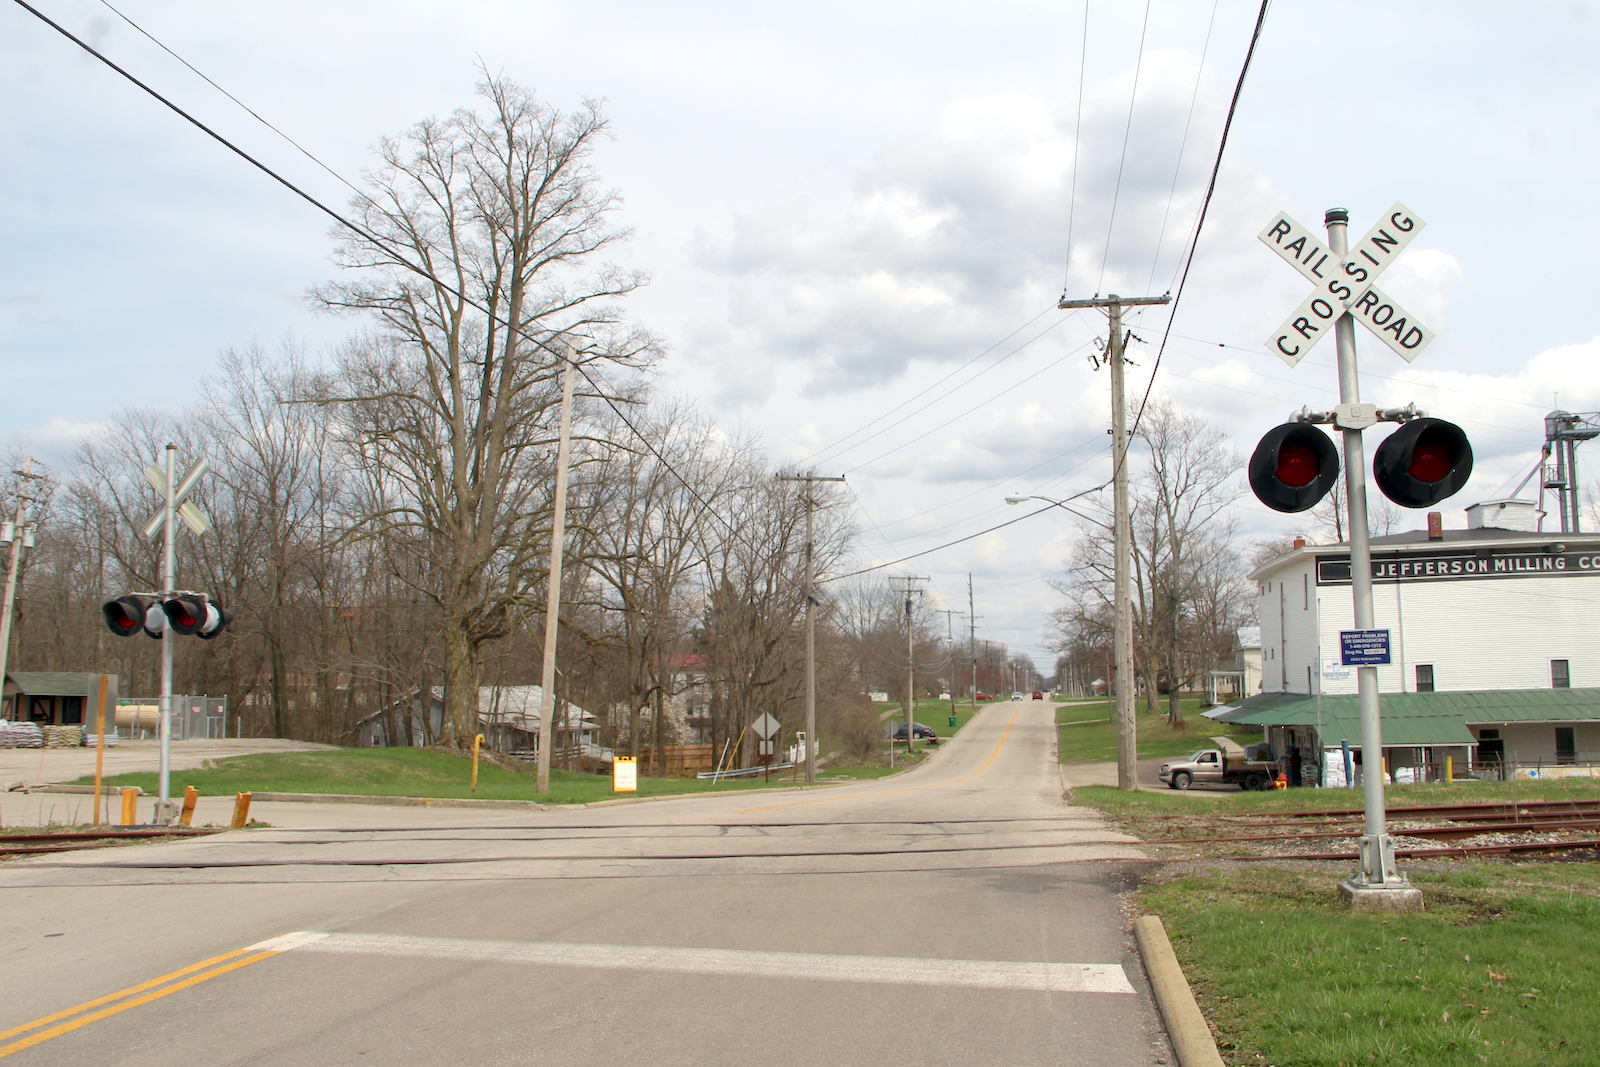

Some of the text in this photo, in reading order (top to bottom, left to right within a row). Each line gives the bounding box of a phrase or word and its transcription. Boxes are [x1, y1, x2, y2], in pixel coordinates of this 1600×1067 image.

[1267, 219, 1423, 349] RAIL ROAD
[1276, 212, 1415, 357] CROSSING
[1375, 560, 1489, 577] JEFFERSON
[1494, 557, 1566, 572] MILLING
